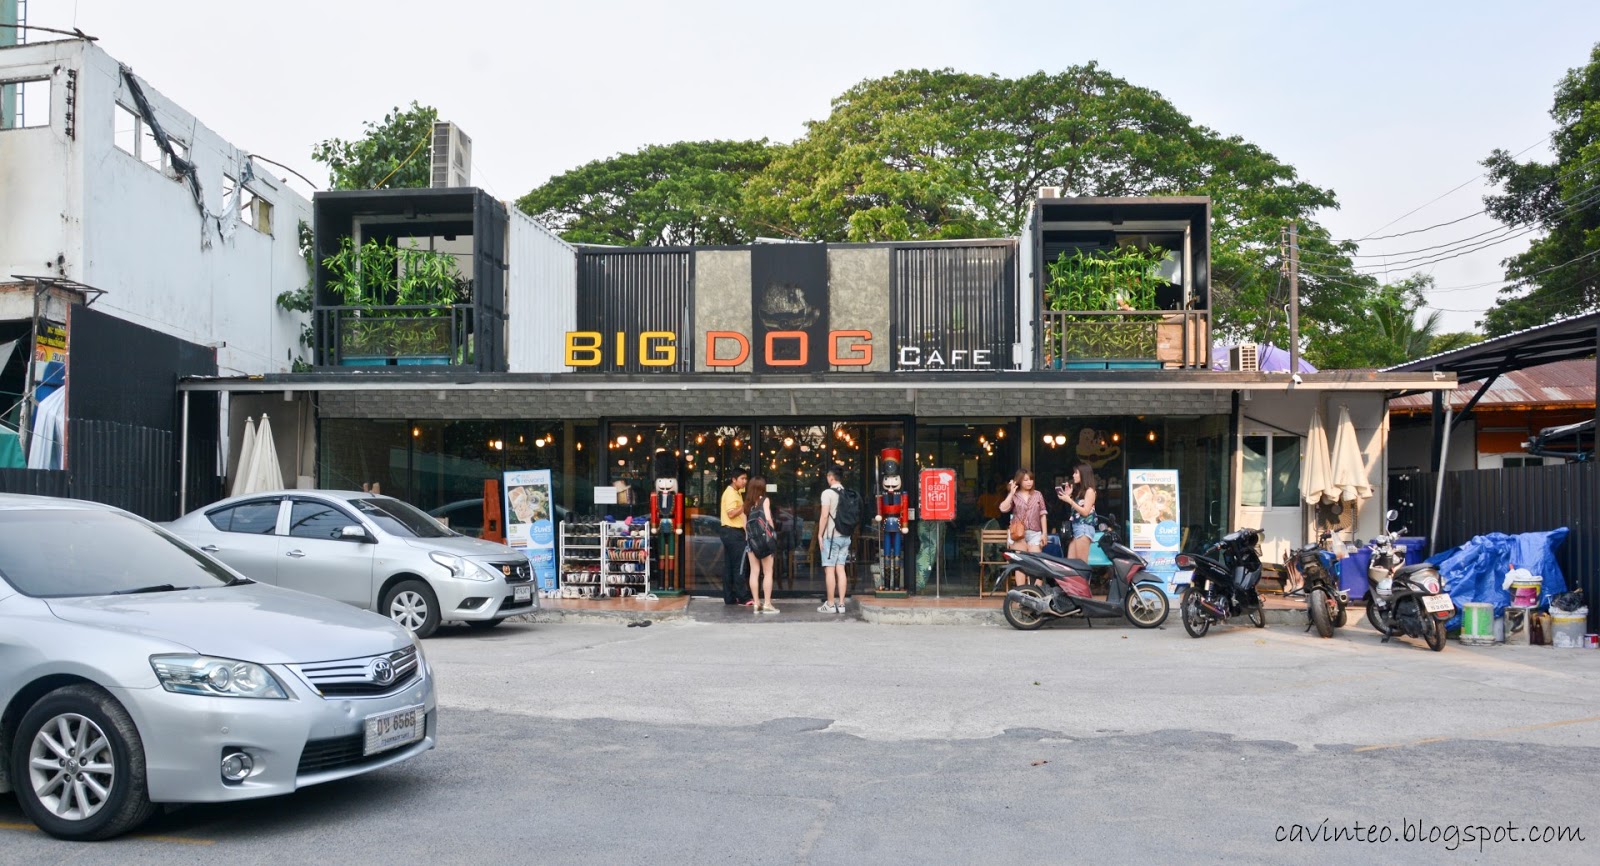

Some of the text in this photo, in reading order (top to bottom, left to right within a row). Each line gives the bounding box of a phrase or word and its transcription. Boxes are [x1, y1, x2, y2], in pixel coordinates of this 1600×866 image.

[565, 330, 991, 367] BIG DOG CAFE
[928, 481, 947, 491] อร่อย
[393, 711, 416, 730] 6565
